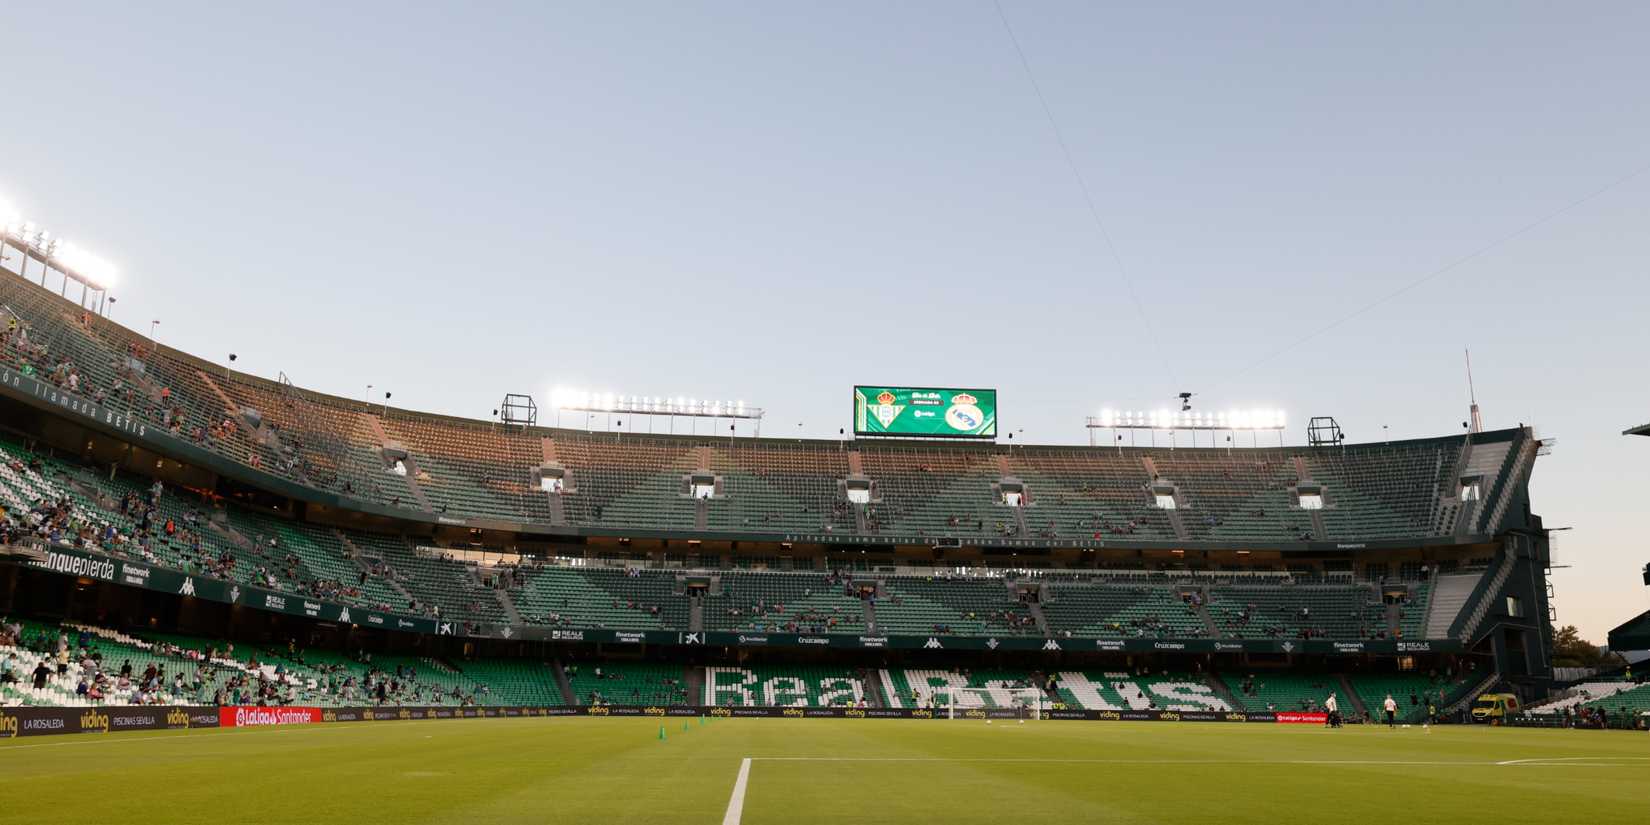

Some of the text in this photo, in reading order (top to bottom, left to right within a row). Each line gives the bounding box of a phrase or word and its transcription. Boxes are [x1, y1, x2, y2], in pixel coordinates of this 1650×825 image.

[34, 383, 97, 418] llamada
[106, 411, 146, 437] BETIS
[798, 637, 830, 645] Cruzcampo
[1153, 641, 1185, 649] Cruzcampo
[588, 705, 609, 716] viding
[644, 706, 665, 717] viding
[711, 707, 731, 717] viding
[783, 708, 803, 718] viding
[845, 708, 865, 718] viding
[911, 709, 932, 719] viding
[167, 707, 189, 729] viding
[245, 707, 311, 725] LaLiga Santander
[1099, 711, 1120, 721] viding
[1159, 712, 1180, 721] viding
[1225, 713, 1247, 722] viding
[23, 718, 65, 730] LA ROSALEDA
[80, 708, 109, 736] viding
